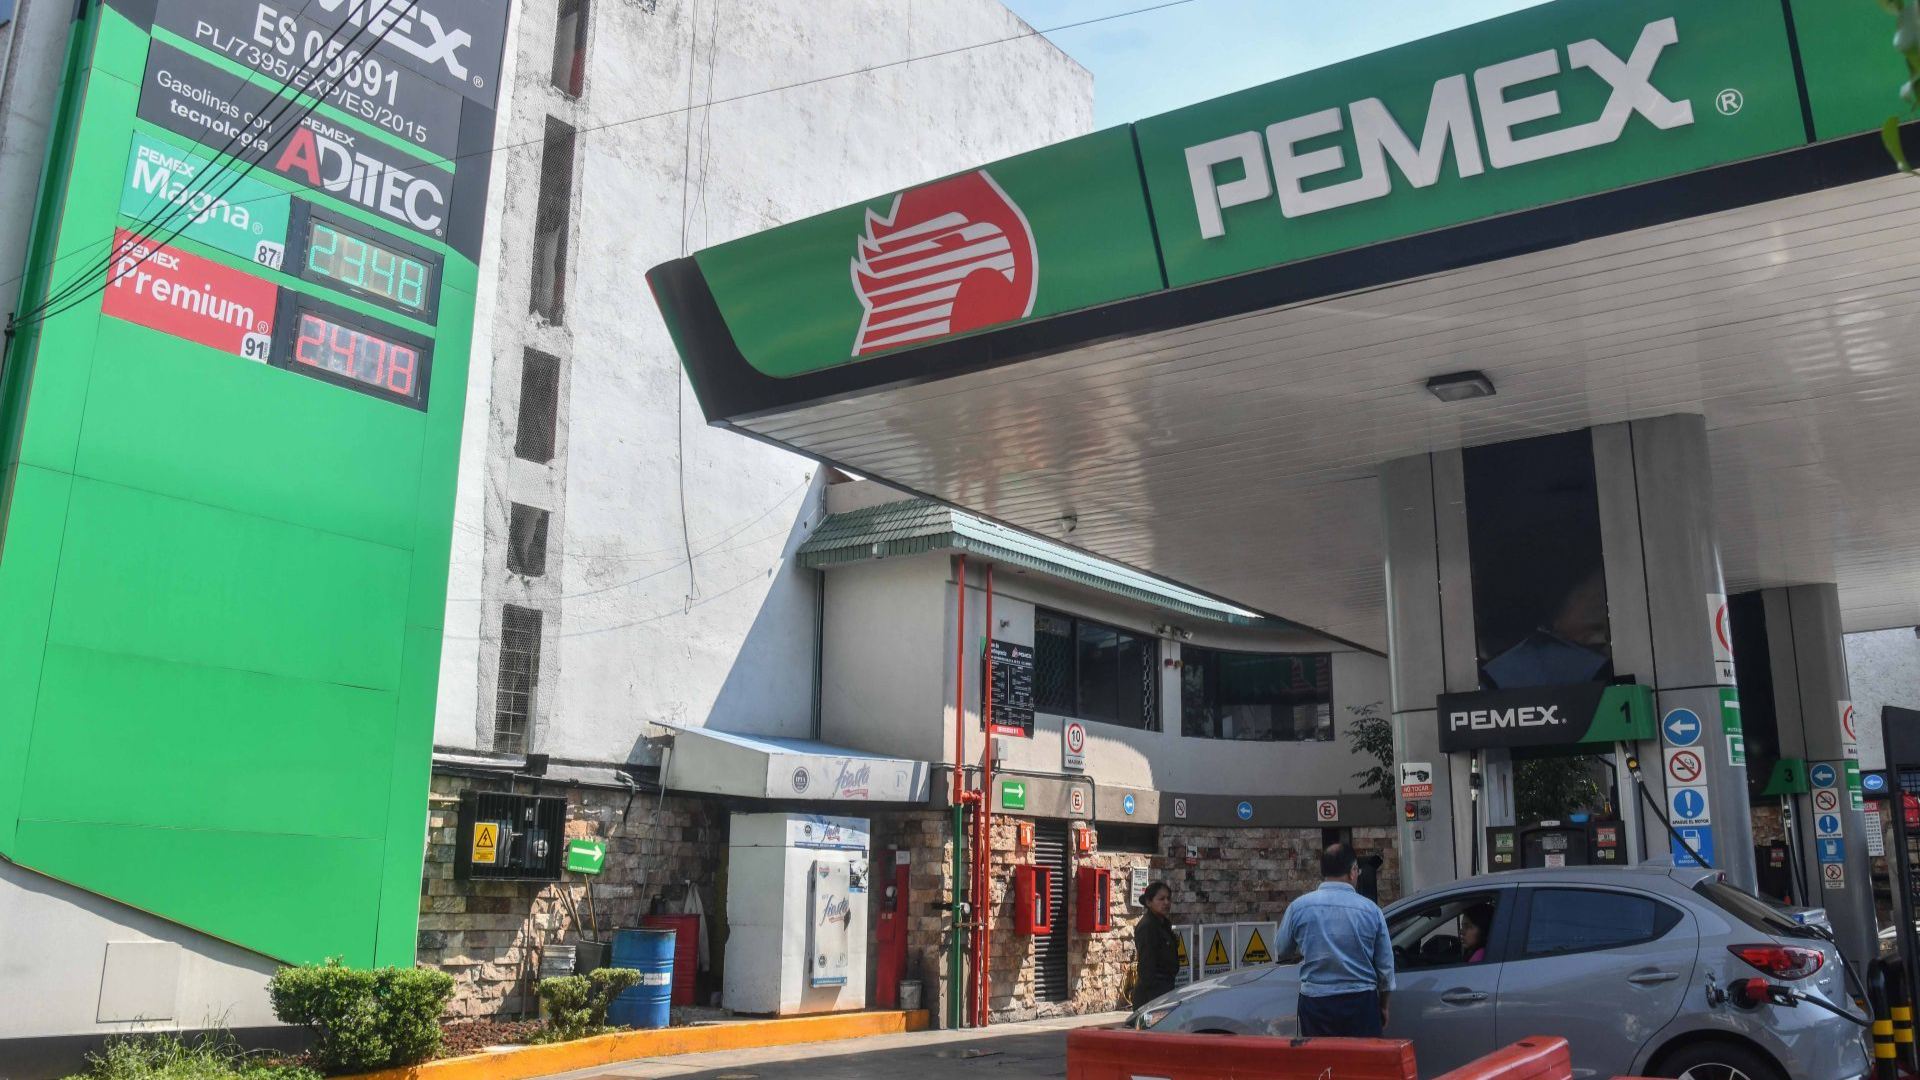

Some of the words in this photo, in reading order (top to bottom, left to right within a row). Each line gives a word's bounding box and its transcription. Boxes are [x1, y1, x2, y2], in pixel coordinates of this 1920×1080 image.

[253, 3, 297, 56] ES
[303, 30, 399, 106] 05691
[195, 20, 427, 143] PL/7395/EXP/ES/2015
[157, 70, 240, 119] Gasolinas
[244, 112, 273, 133] con
[301, 115, 356, 148] PEMEX
[1184, 17, 1695, 240] PEMEX
[137, 145, 196, 178] PEMEX
[132, 158, 250, 230] Magna
[121, 240, 181, 271] PEMEX
[257, 245, 277, 266] 87
[114, 256, 254, 330] Premium
[245, 338, 265, 360] 91
[1450, 706, 1559, 732] PEMEX
[1620, 701, 1632, 724] 1
[1071, 730, 1081, 742] 10
[1784, 768, 1794, 783] 3
